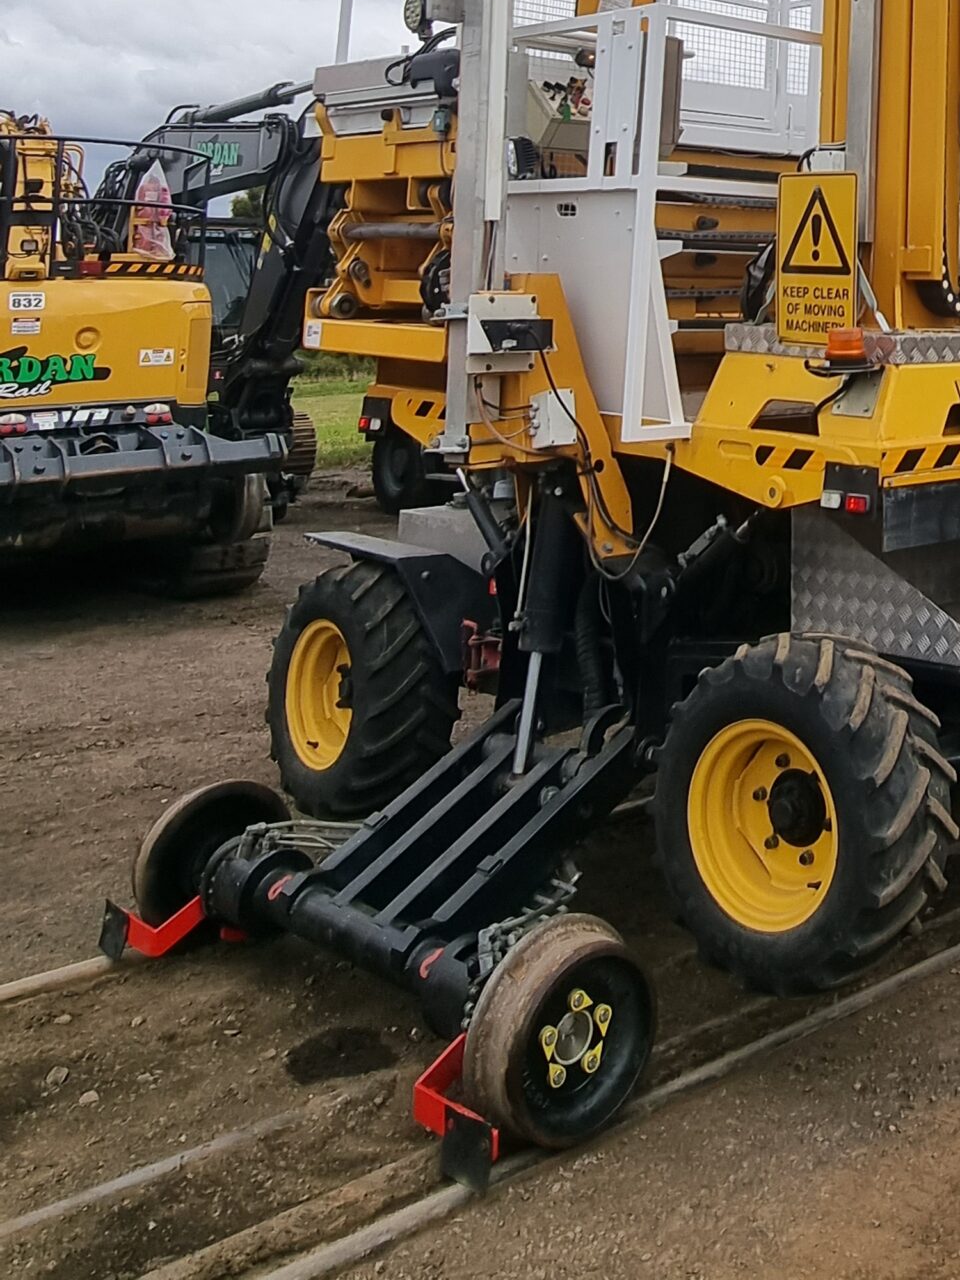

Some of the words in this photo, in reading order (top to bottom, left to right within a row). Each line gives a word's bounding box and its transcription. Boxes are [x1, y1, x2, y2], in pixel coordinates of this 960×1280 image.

[783, 286, 809, 298] KEEP
[813, 287, 849, 300] CLEAR
[12, 298, 42, 308] 832
[787, 303, 800, 314] OF
[804, 304, 845, 317] MOVING
[0, 381, 51, 398] Rail
